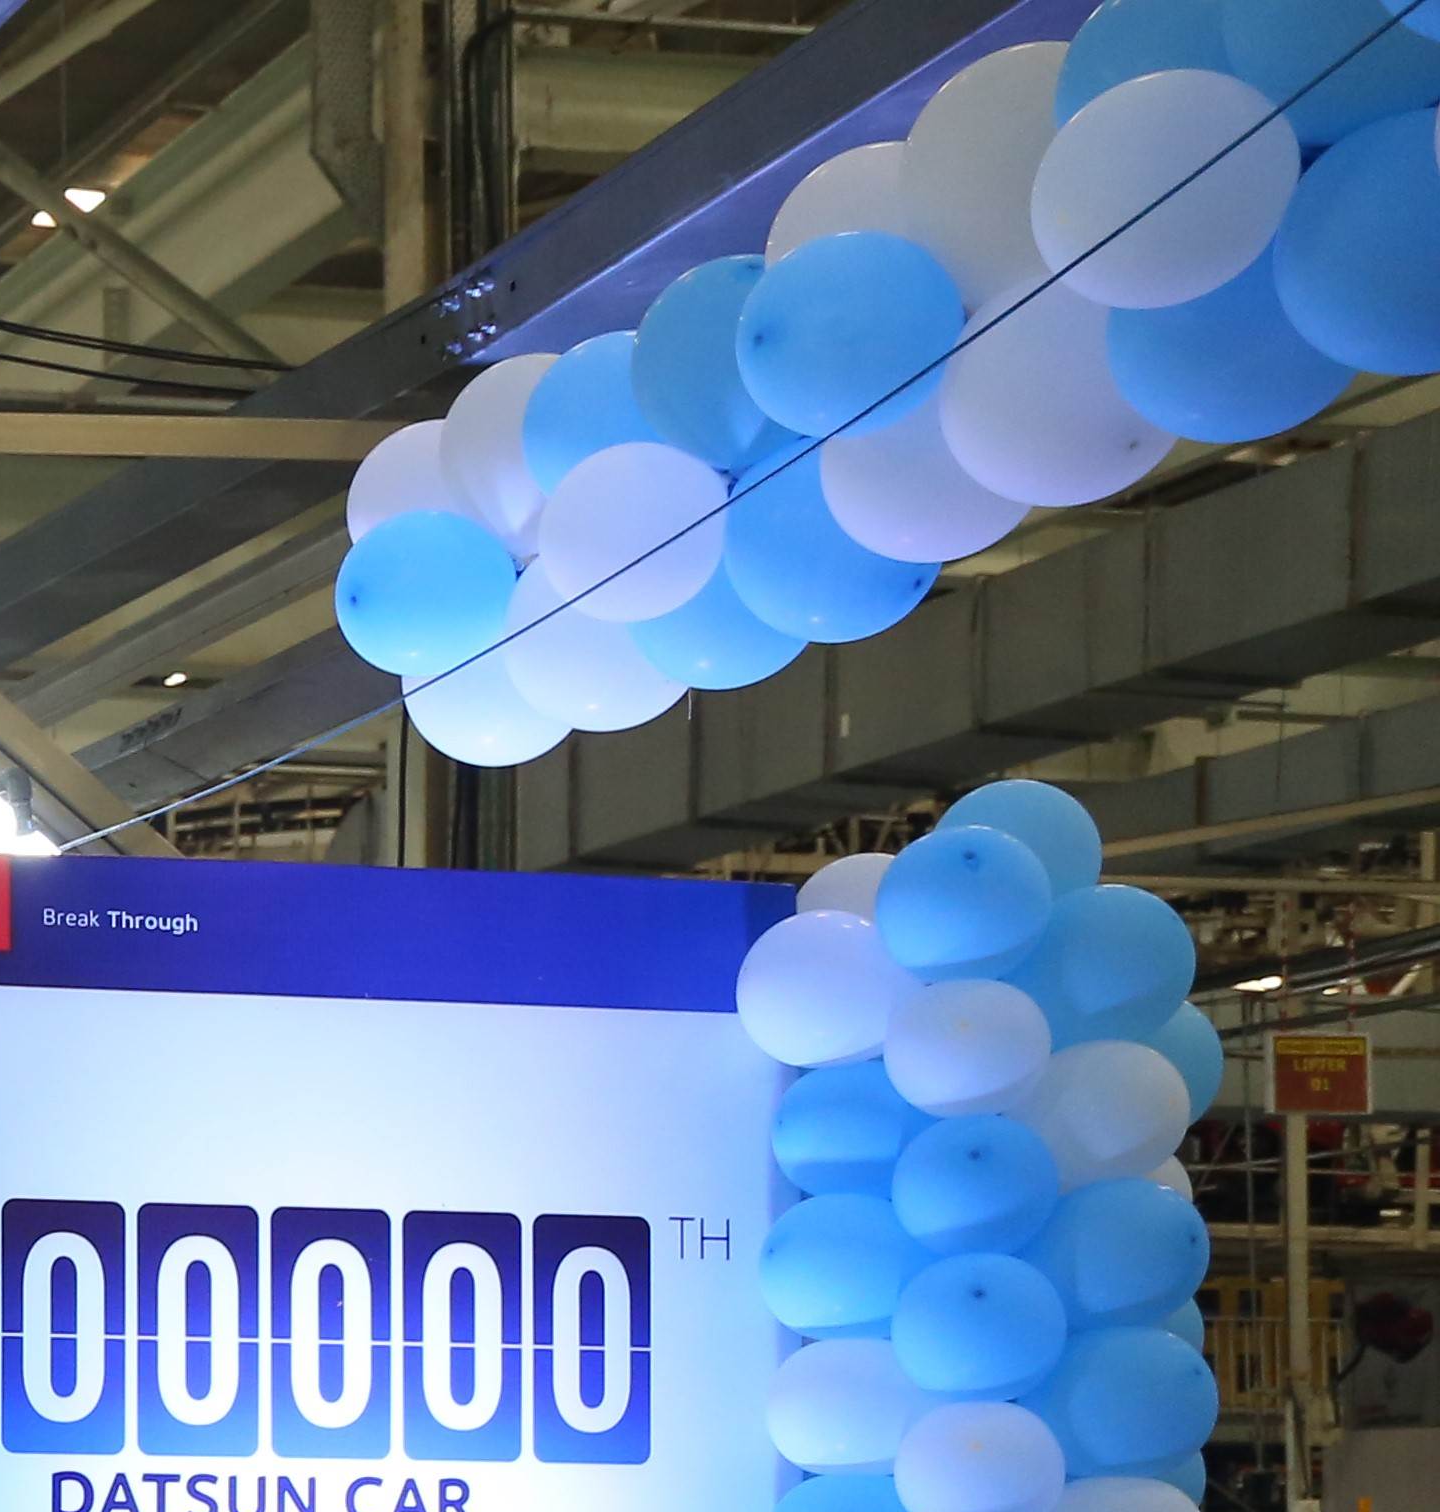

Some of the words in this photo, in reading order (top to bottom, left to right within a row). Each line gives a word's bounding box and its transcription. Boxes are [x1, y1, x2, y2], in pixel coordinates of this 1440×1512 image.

[42, 907, 101, 930] Break
[106, 909, 199, 936] Through
[668, 1216, 731, 1262] TH
